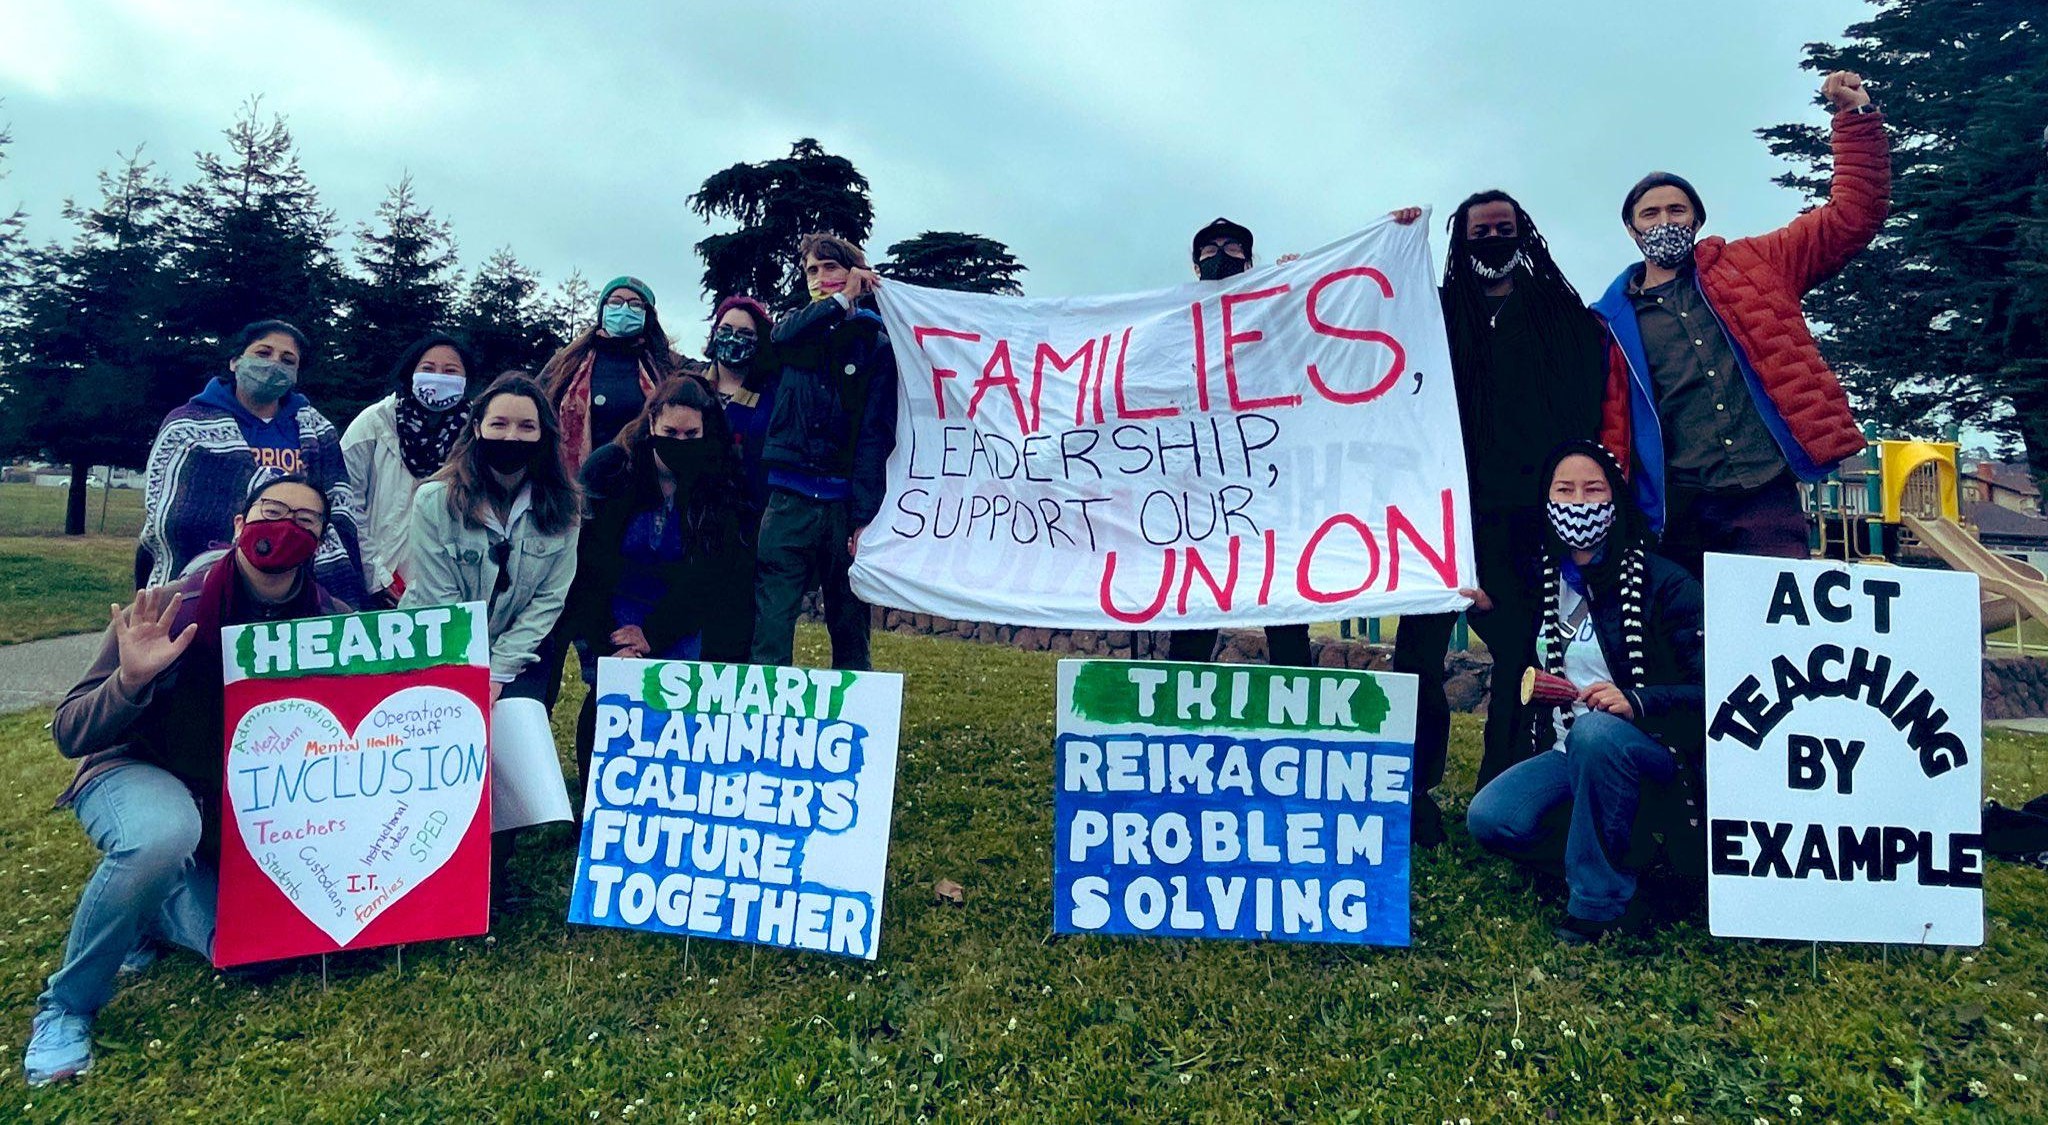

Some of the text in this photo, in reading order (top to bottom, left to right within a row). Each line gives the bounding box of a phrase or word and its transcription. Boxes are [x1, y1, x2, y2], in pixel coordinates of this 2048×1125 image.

[913, 266, 1423, 436] FAMILIES,
[908, 414, 1280, 488] LEADERSHIP,
[891, 488, 1113, 552] SUPPORT
[1139, 485, 1261, 546] OUR
[1100, 488, 1458, 624] UNION
[1766, 570, 1901, 634] ACT
[253, 608, 451, 674] HEART
[373, 699, 463, 728] Operations
[658, 662, 843, 720] SMART
[1127, 667, 1361, 727] THINK
[1707, 643, 1969, 779] TEACHING
[234, 700, 340, 753] Administration
[268, 726, 303, 755] Team
[304, 733, 404, 758] Mental Health
[402, 720, 442, 739] Staff
[592, 703, 853, 773] PLANNING
[238, 743, 487, 813] INCLUSION
[1064, 740, 1412, 804] REIMAGINE
[1787, 733, 1866, 795] BY
[253, 818, 347, 846] Teachers
[359, 799, 410, 868] Instructional
[381, 824, 411, 863] Aides
[409, 809, 449, 863] SPED
[590, 809, 797, 886] FUTURE
[1069, 810, 1384, 865] PROBLEM
[1710, 818, 1983, 889] EXAMPLE
[258, 851, 303, 902] Students
[299, 845, 348, 918] Custodians
[346, 873, 380, 894] I.T.
[1071, 875, 1368, 934] SOLVING
[588, 864, 868, 955] TOGETHER
